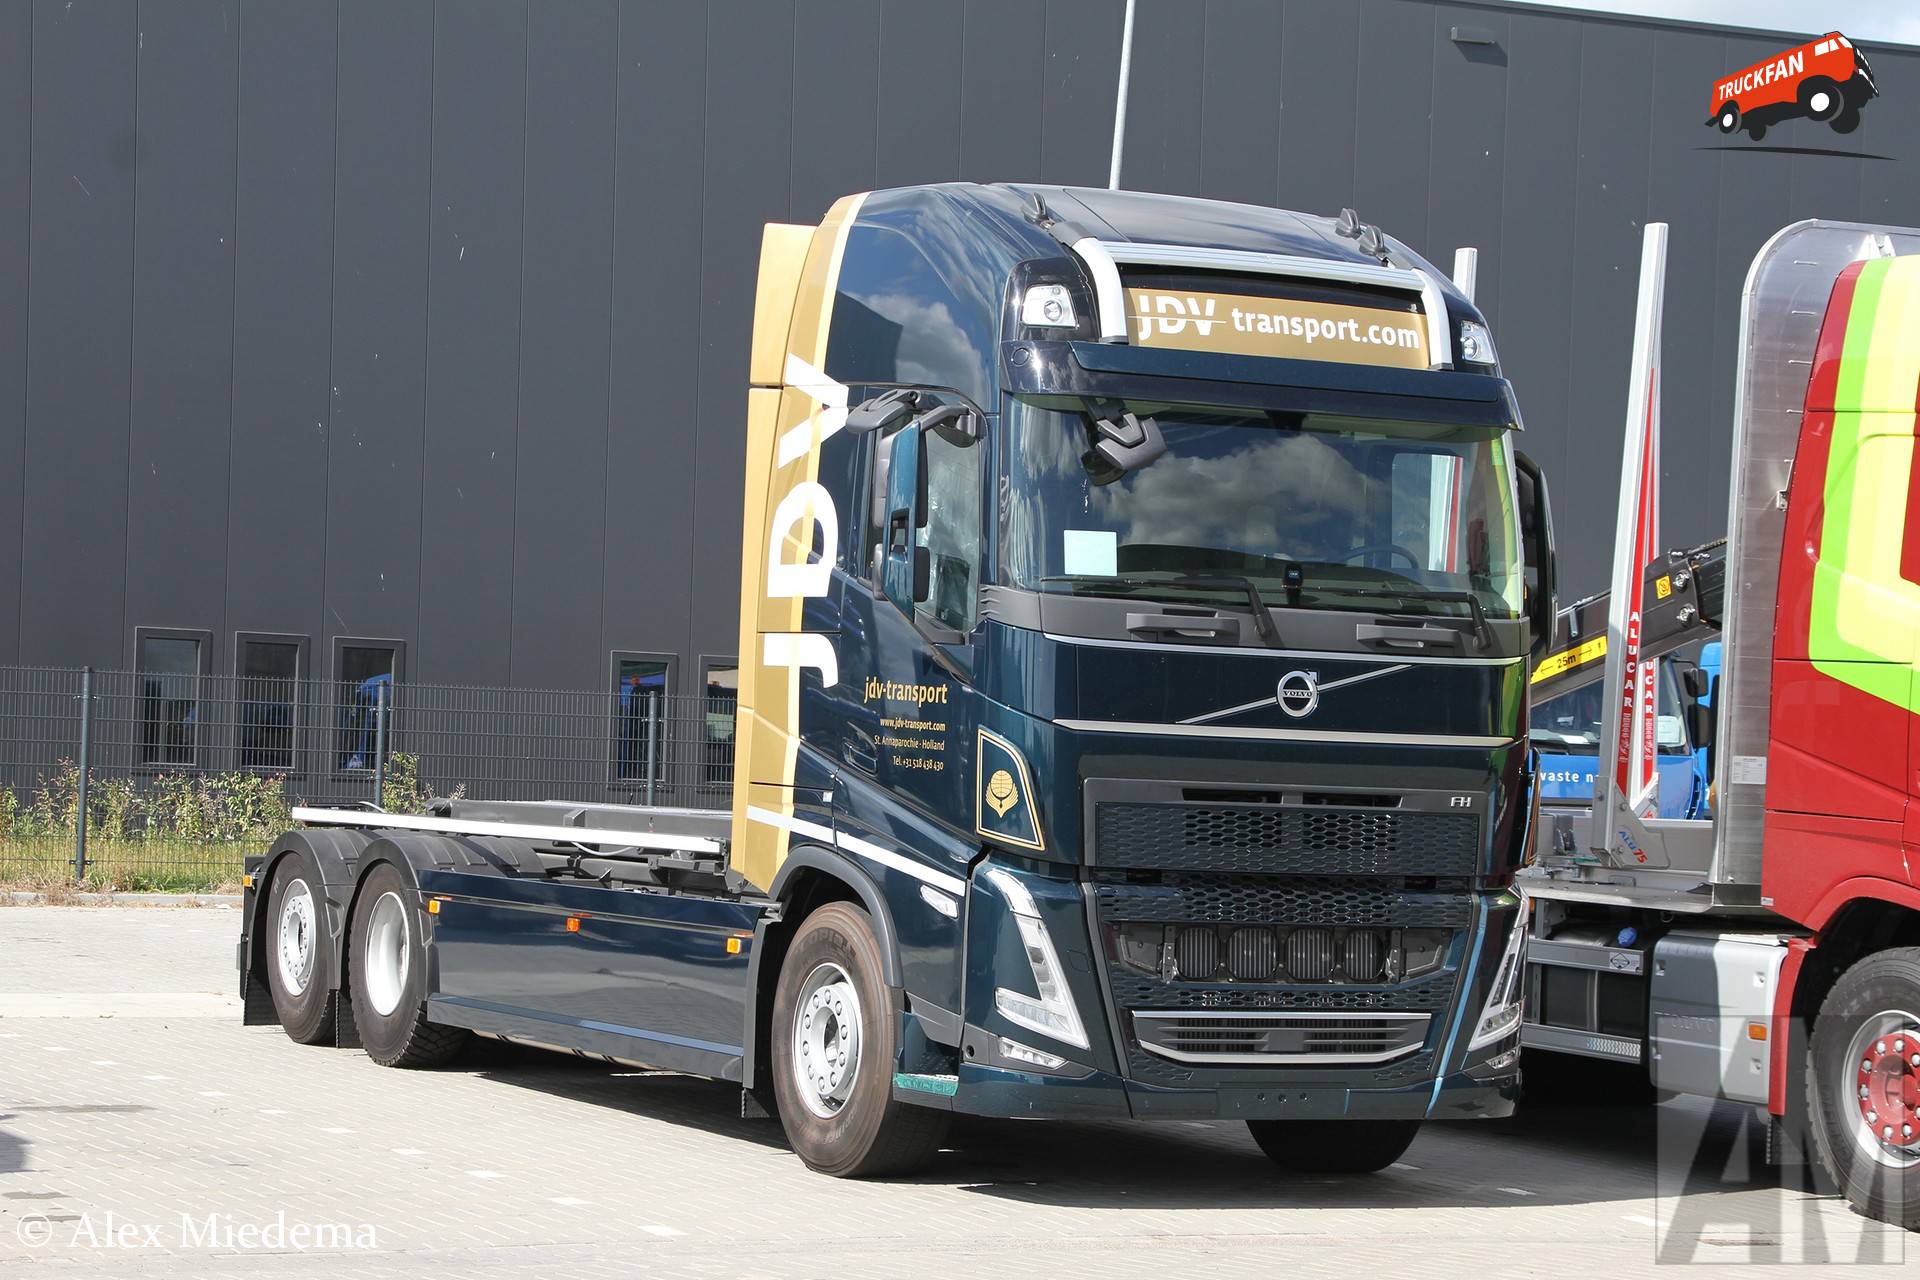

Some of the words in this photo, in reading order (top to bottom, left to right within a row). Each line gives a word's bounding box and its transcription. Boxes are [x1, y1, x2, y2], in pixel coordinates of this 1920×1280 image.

[1137, 294, 1218, 341] JDV
[1231, 307, 1420, 349] transport.com
[763, 352, 849, 689] JDV
[1556, 654, 1577, 669] 25m
[1623, 611, 1641, 708] ALUCAR
[1282, 690, 1313, 698] VOLVO
[1643, 661, 1655, 714] UCAR
[880, 717, 946, 732] www.jdv-transport.com
[922, 740, 945, 751] Holland
[1450, 796, 1472, 808] FH
